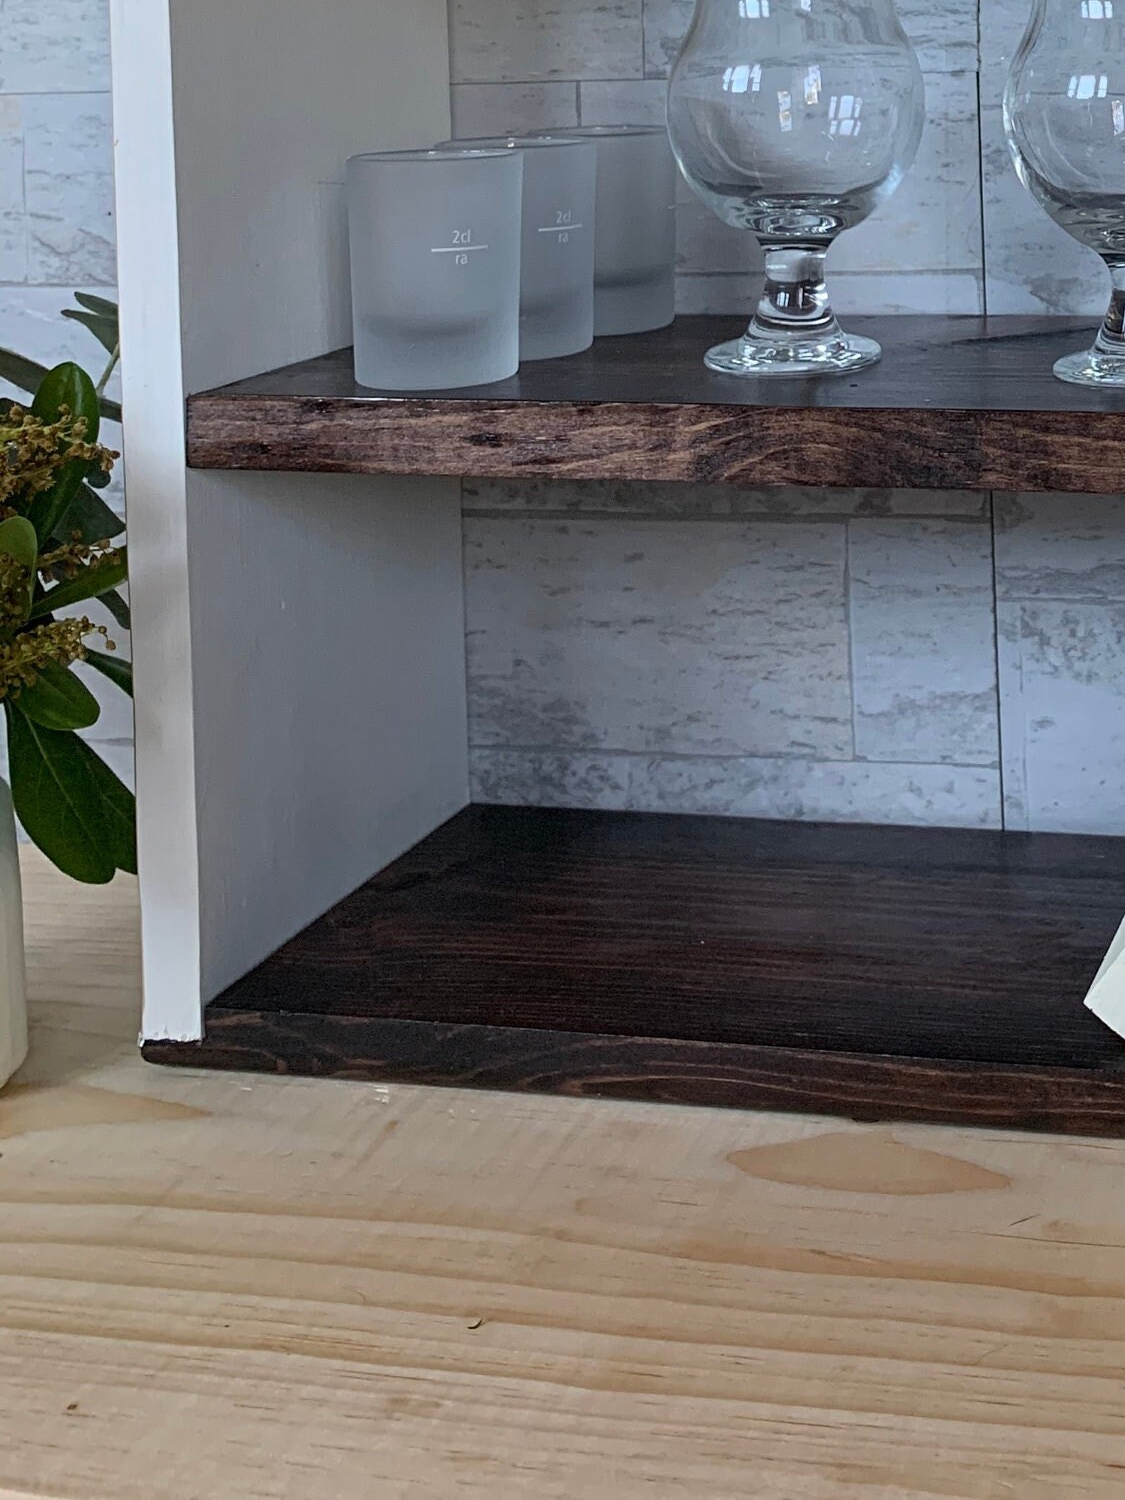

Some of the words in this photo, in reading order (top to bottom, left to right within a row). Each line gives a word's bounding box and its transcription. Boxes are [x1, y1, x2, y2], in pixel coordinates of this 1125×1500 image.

[556, 209, 571, 224] 2cl
[451, 228, 471, 244] 2cl
[558, 232, 569, 243] ra
[455, 253, 468, 265] ra
